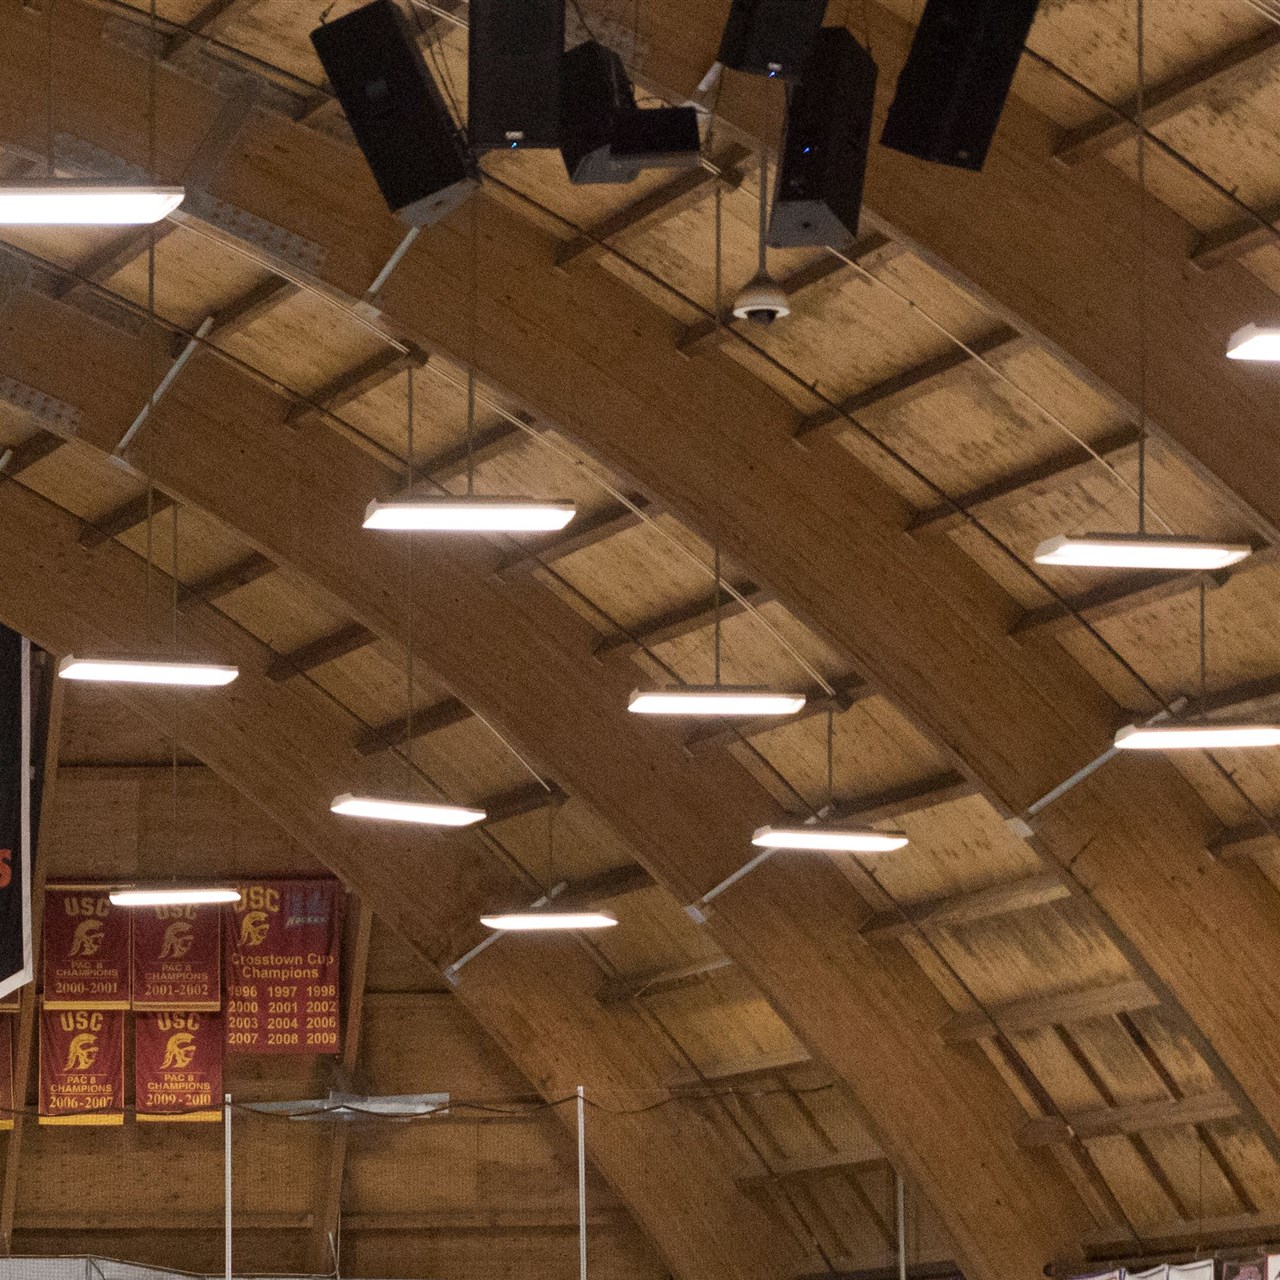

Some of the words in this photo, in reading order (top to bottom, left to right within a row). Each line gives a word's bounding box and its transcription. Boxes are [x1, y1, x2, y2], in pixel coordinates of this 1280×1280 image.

[234, 885, 279, 913] USC
[64, 897, 111, 917] USC
[231, 953, 303, 966] Crosstown
[308, 953, 334, 968] Cup
[56, 969, 118, 977] CHAMPIONS
[145, 972, 207, 981] CHAMPIONS
[242, 967, 319, 981] Champions
[56, 982, 118, 994] 2000-2001
[145, 984, 209, 996] 2001-2002
[229, 986, 257, 997] 1996
[267, 986, 297, 998] 1997
[306, 985, 336, 997] 1998
[228, 1002, 258, 1013] 2000
[268, 1002, 298, 1014] 2001
[306, 1001, 336, 1013] 2002
[60, 1012, 103, 1031] USC
[157, 1012, 201, 1031] USC
[228, 1017, 258, 1028] 2003
[267, 1018, 298, 1029] 2004
[228, 1033, 258, 1044] 2007
[267, 1033, 298, 1045] 2008
[306, 1032, 336, 1044] 2009
[67, 1077, 89, 1085] PAC
[164, 1074, 186, 1083] PAC
[50, 1085, 112, 1093] CHAMPIONS
[147, 1082, 210, 1091] CHAMPIONS
[50, 1096, 113, 1109] 2006-2007
